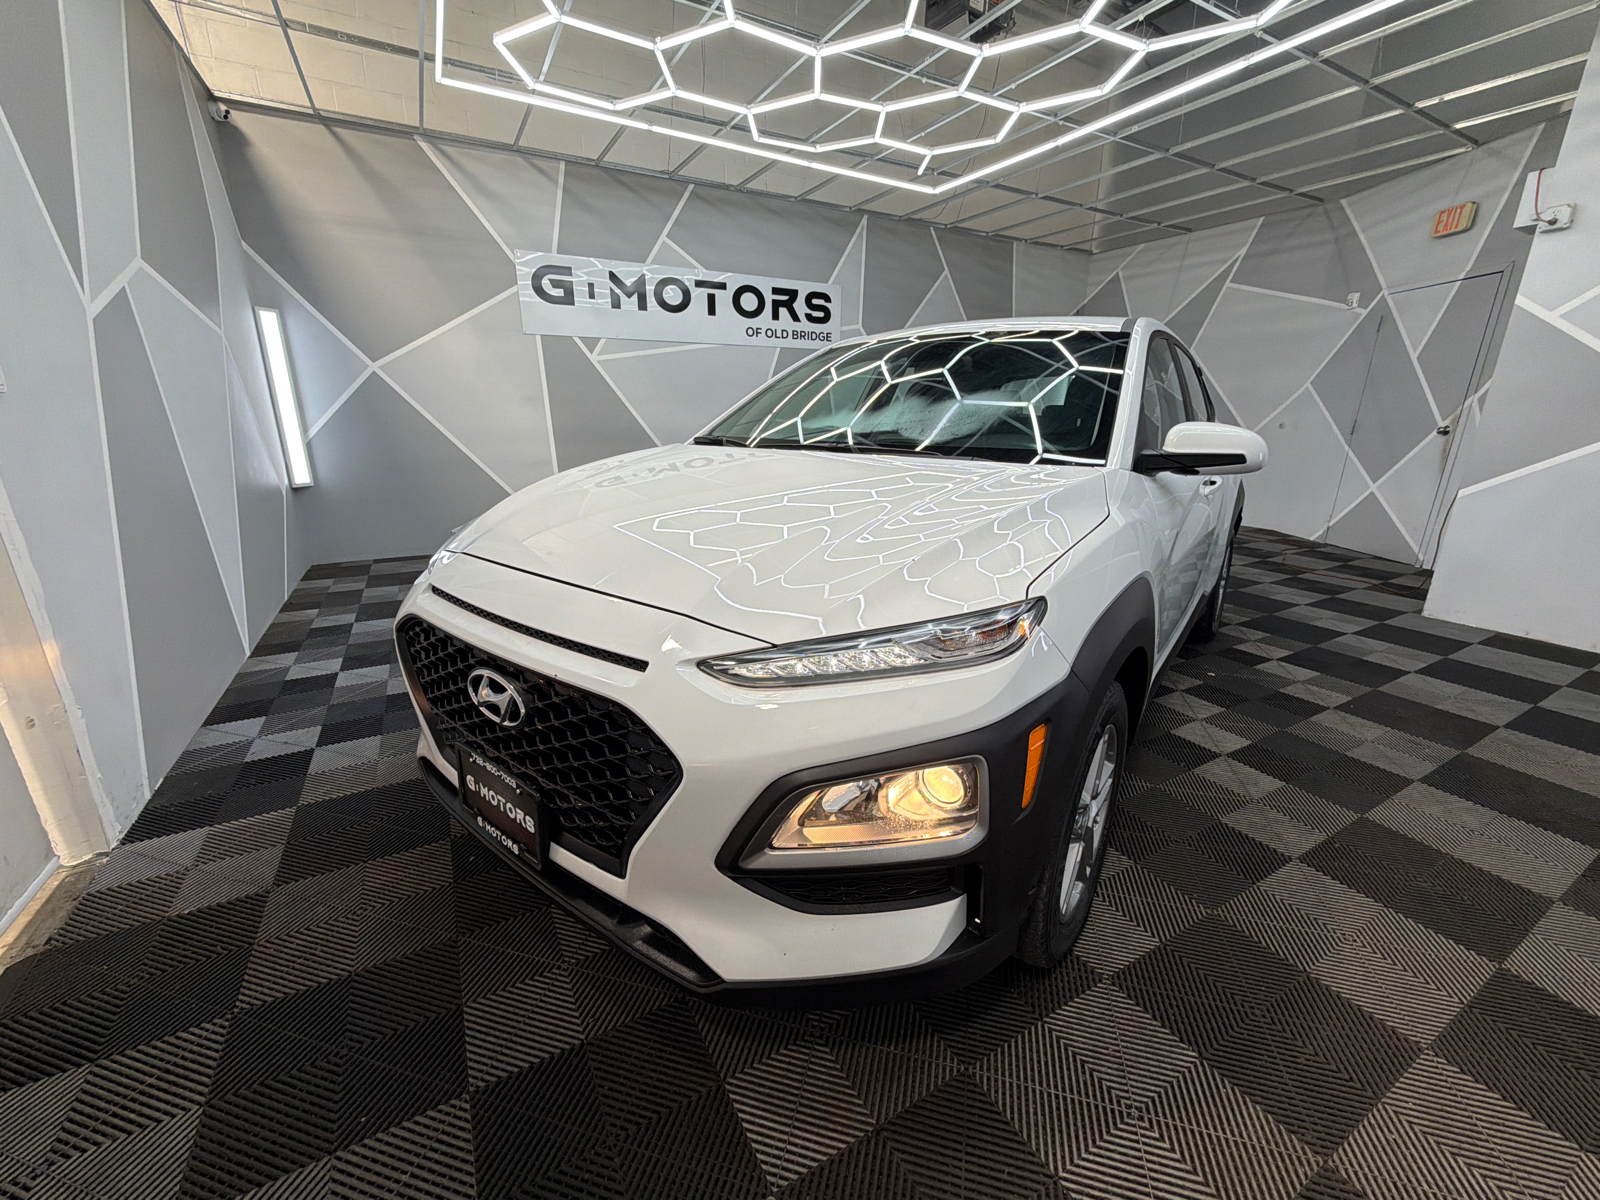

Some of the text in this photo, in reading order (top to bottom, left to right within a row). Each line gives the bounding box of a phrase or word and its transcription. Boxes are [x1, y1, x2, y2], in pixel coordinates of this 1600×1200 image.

[1434, 204, 1467, 235] EXIT
[745, 326, 833, 342] OF OLD BRIDGE
